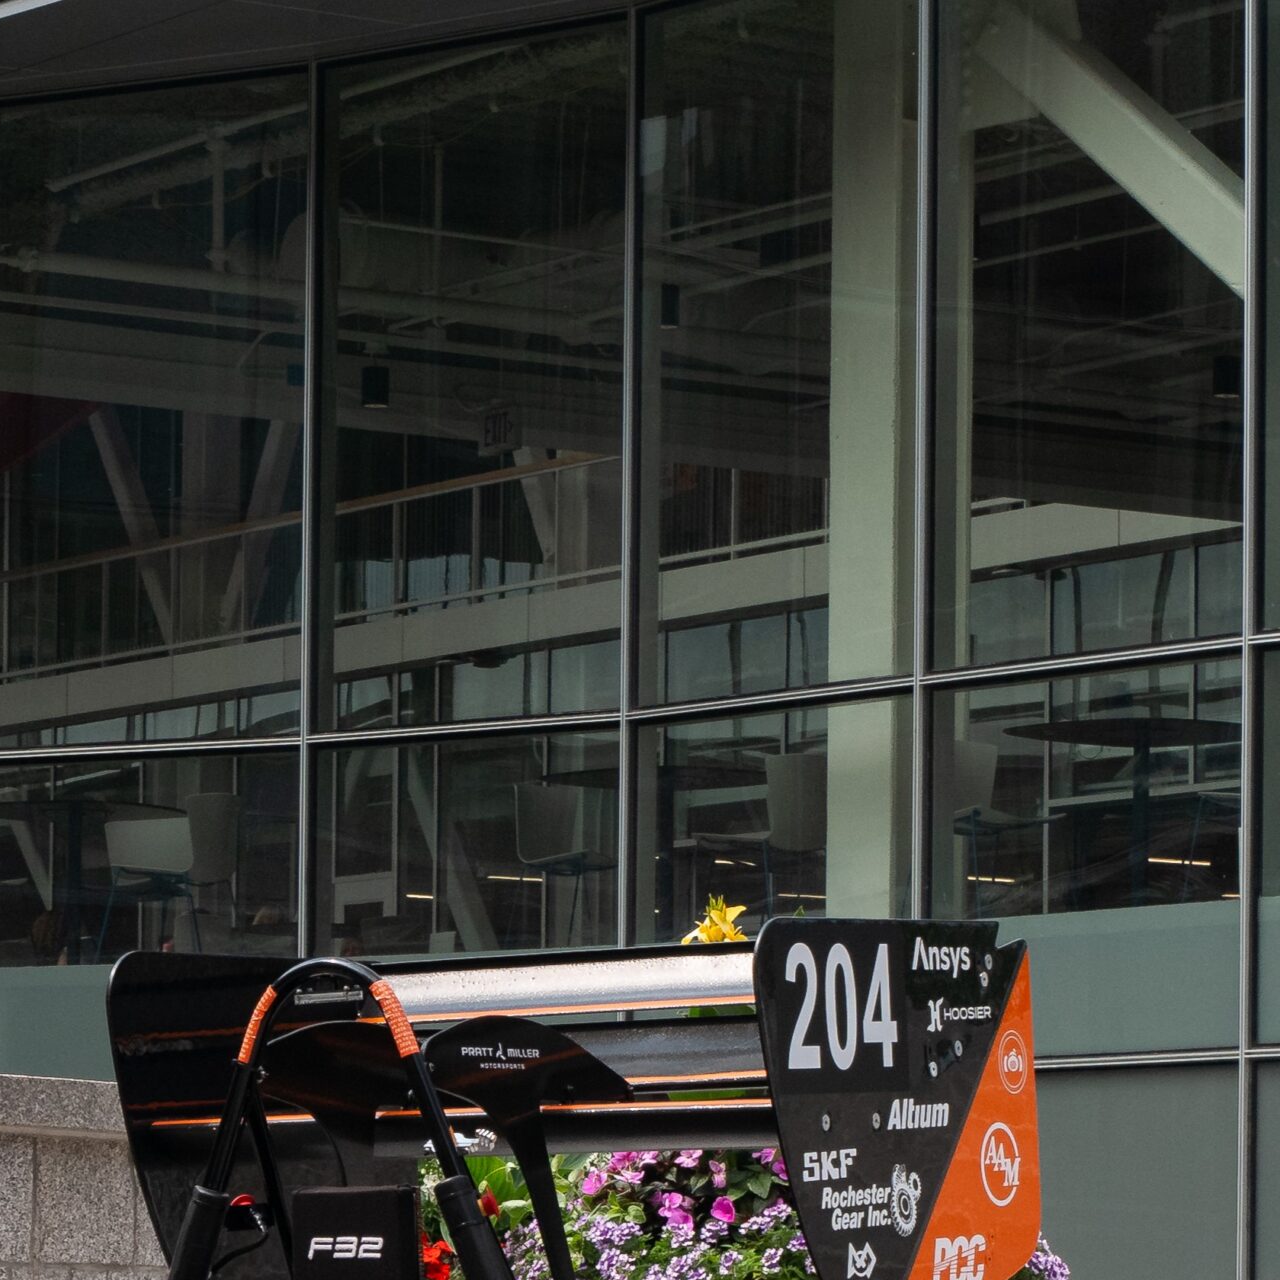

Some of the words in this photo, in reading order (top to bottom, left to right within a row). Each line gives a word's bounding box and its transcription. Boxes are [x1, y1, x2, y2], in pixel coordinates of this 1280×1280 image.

[912, 936, 971, 979] Ansys
[785, 942, 899, 1071] 204
[943, 1006, 992, 1021] HOOSIER
[461, 1047, 493, 1057] PRATT
[507, 1048, 540, 1058] MILLER
[887, 1098, 950, 1130] Altium
[803, 1148, 857, 1182] SKF
[985, 1136, 1021, 1187] AAM
[821, 1183, 891, 1210] Rochester
[831, 1207, 862, 1231] Gear
[867, 1204, 892, 1228] Inc.
[307, 1236, 384, 1260] F32
